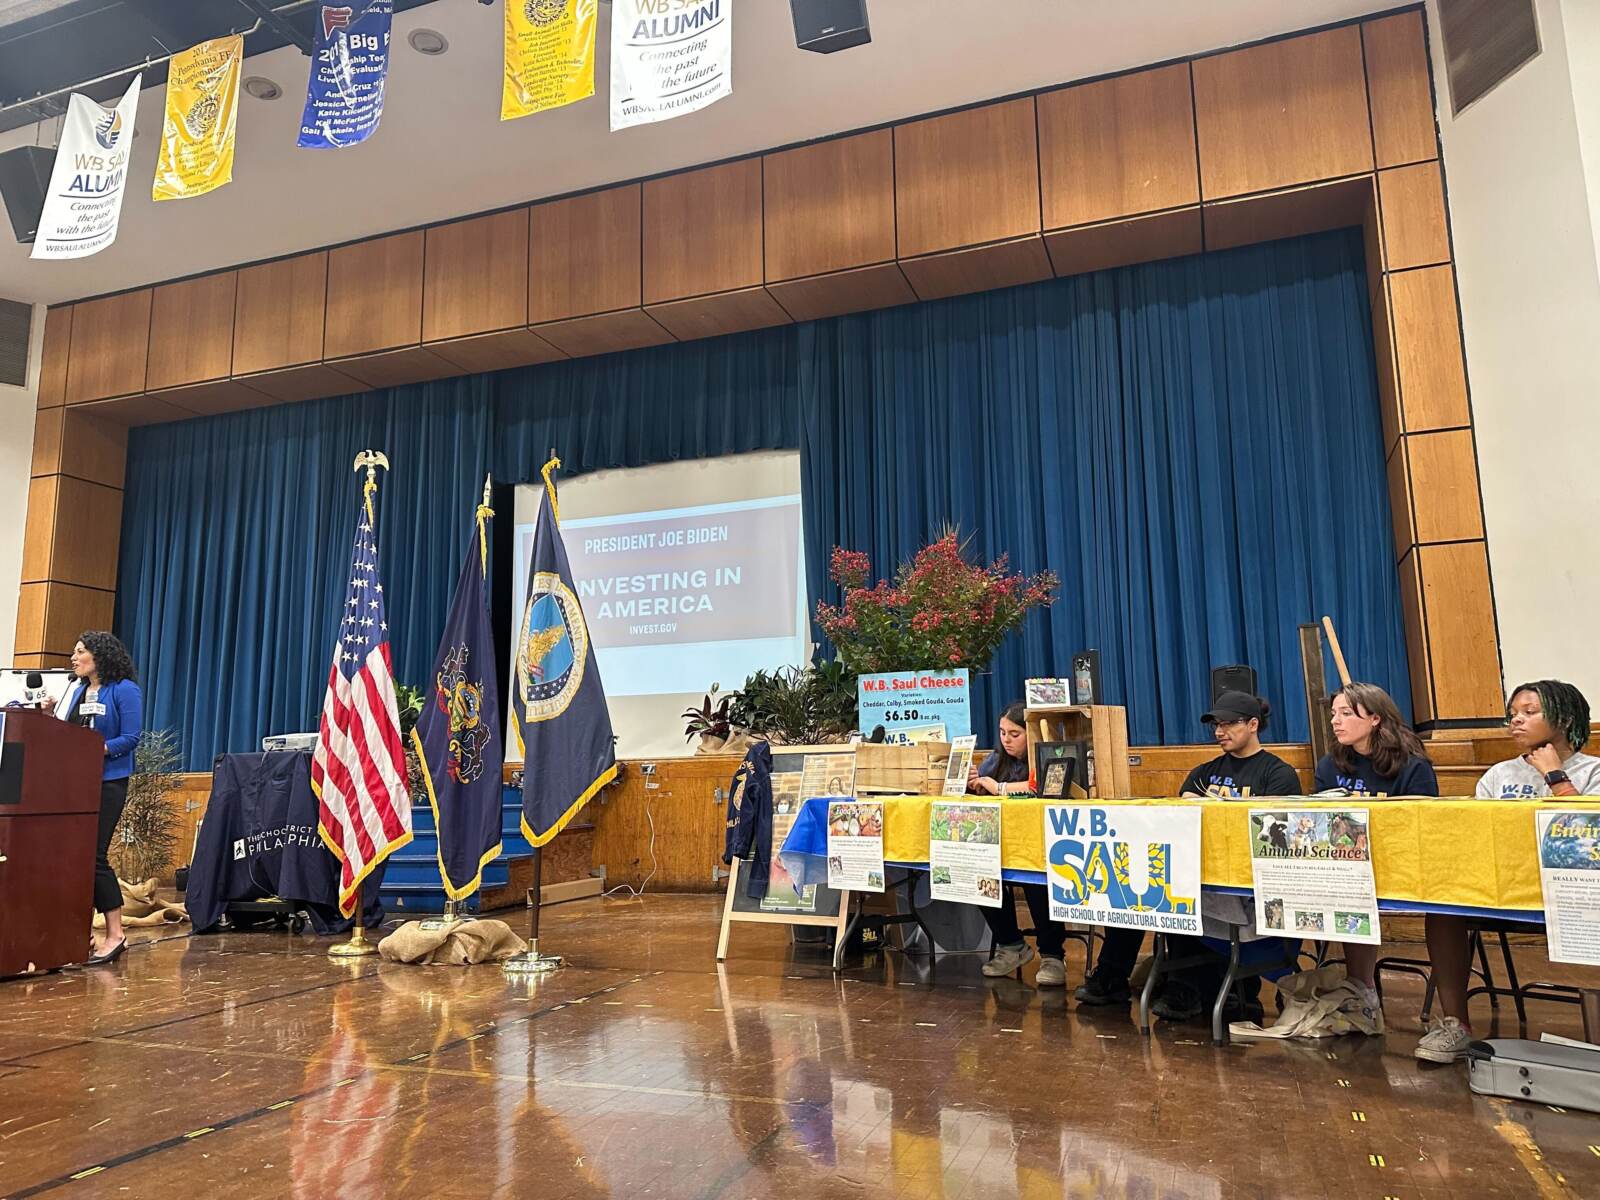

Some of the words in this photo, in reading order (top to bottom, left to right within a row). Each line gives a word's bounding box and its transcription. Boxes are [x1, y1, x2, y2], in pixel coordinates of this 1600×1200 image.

[632, 0, 720, 39] ALUMNI
[350, 34, 378, 50] Big
[639, 39, 708, 61] Connecting
[674, 56, 699, 75] past
[662, 77, 680, 89] the
[684, 63, 717, 83] future
[75, 153, 104, 170] WB
[77, 214, 93, 222] the
[56, 225, 79, 234] with
[585, 533, 656, 554] PRESIDENT
[658, 529, 684, 547] JOE
[687, 526, 728, 545] BIDEN
[573, 569, 707, 598] NVESTING
[715, 566, 741, 587] IN
[597, 594, 713, 620] AMERICA
[629, 622, 677, 635] INVEST.GOV
[863, 680, 889, 692] W.B.
[892, 677, 917, 689] Saul
[920, 676, 964, 688] Cheese
[37, 690, 46, 699] 65
[885, 710, 918, 722] $6.50
[1502, 784, 1538, 795] W.B.
[1259, 845, 1307, 858] Animal
[1310, 845, 1362, 859] Science
[1049, 839, 1196, 915] SAUL
[1053, 906, 1070, 919] HIGH
[1070, 908, 1096, 921] SCHOOL
[1097, 910, 1106, 922] OF
[1107, 911, 1159, 928] AGRICULTURAL
[1160, 917, 1197, 931] SCIENCES
